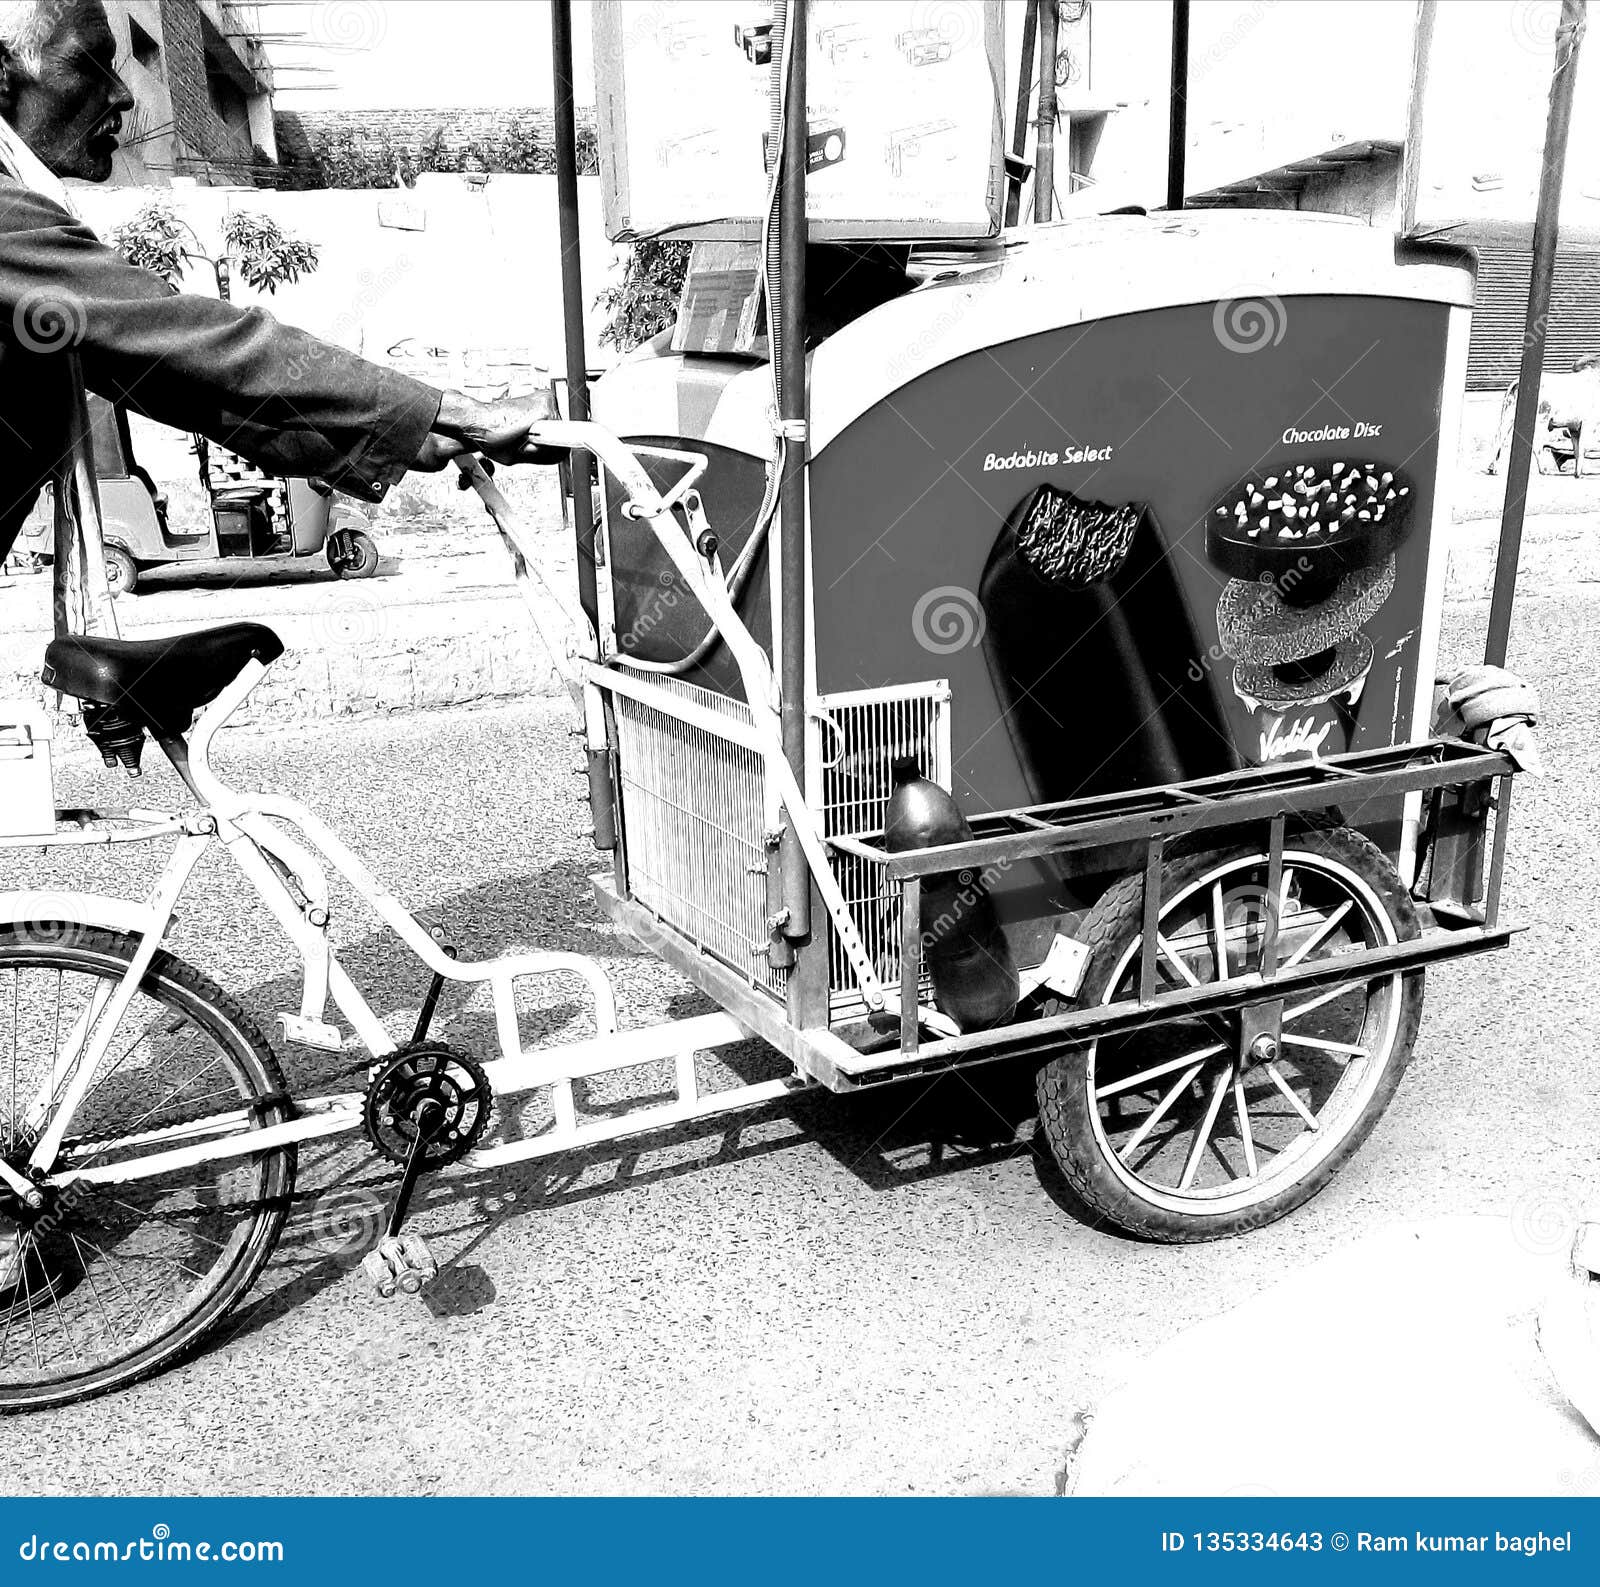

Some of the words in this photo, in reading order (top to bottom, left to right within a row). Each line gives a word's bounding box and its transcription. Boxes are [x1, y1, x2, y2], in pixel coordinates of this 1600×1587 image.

[1282, 425, 1350, 444] Chocolate
[1354, 422, 1382, 437] Disc
[983, 450, 1059, 471] Badabite
[1063, 446, 1113, 464] Select
